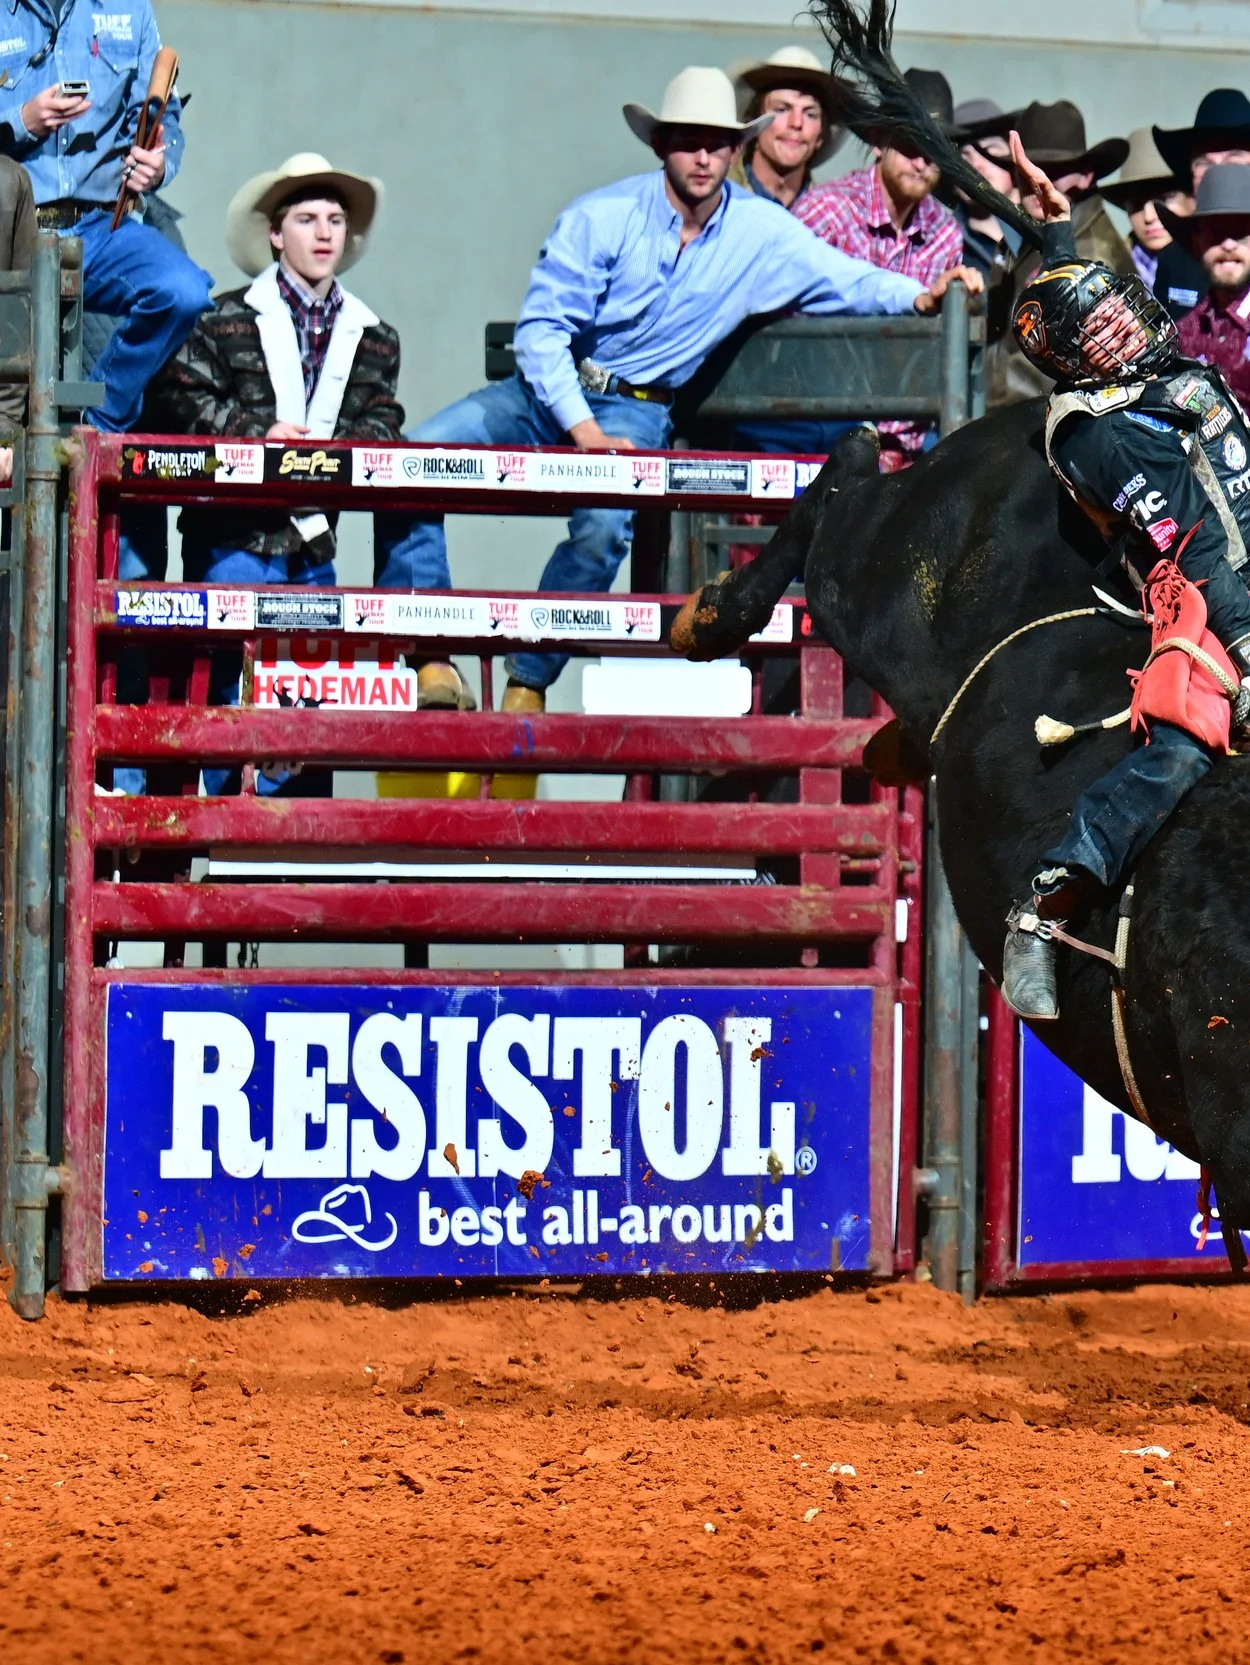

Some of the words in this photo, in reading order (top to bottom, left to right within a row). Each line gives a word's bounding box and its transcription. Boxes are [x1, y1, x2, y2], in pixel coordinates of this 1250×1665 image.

[148, 450, 206, 471] PENDLETON
[224, 449, 255, 460] TUFF
[363, 453, 393, 464] TUFF
[496, 456, 526, 467] TUFF
[423, 458, 484, 474] ROCK&ROLL
[541, 464, 617, 478] PANHANDLE
[632, 461, 661, 473] TUFF
[761, 464, 788, 475] TUFF
[1112, 472, 1147, 513] CAVDER'S
[1152, 522, 1177, 545] unity
[118, 591, 204, 617] RESISTOL
[216, 594, 247, 606] TUFF
[354, 599, 385, 610] TUFF
[398, 606, 475, 620] PANHANDLE
[489, 603, 519, 614] TUFF
[624, 607, 654, 618] TUFF
[551, 609, 611, 625] ROCK&ROLL
[253, 674, 411, 706] HEDEMAN
[159, 1010, 796, 1182] RESISTOL
[417, 1191, 527, 1247] best
[542, 1189, 795, 1246] all-around
